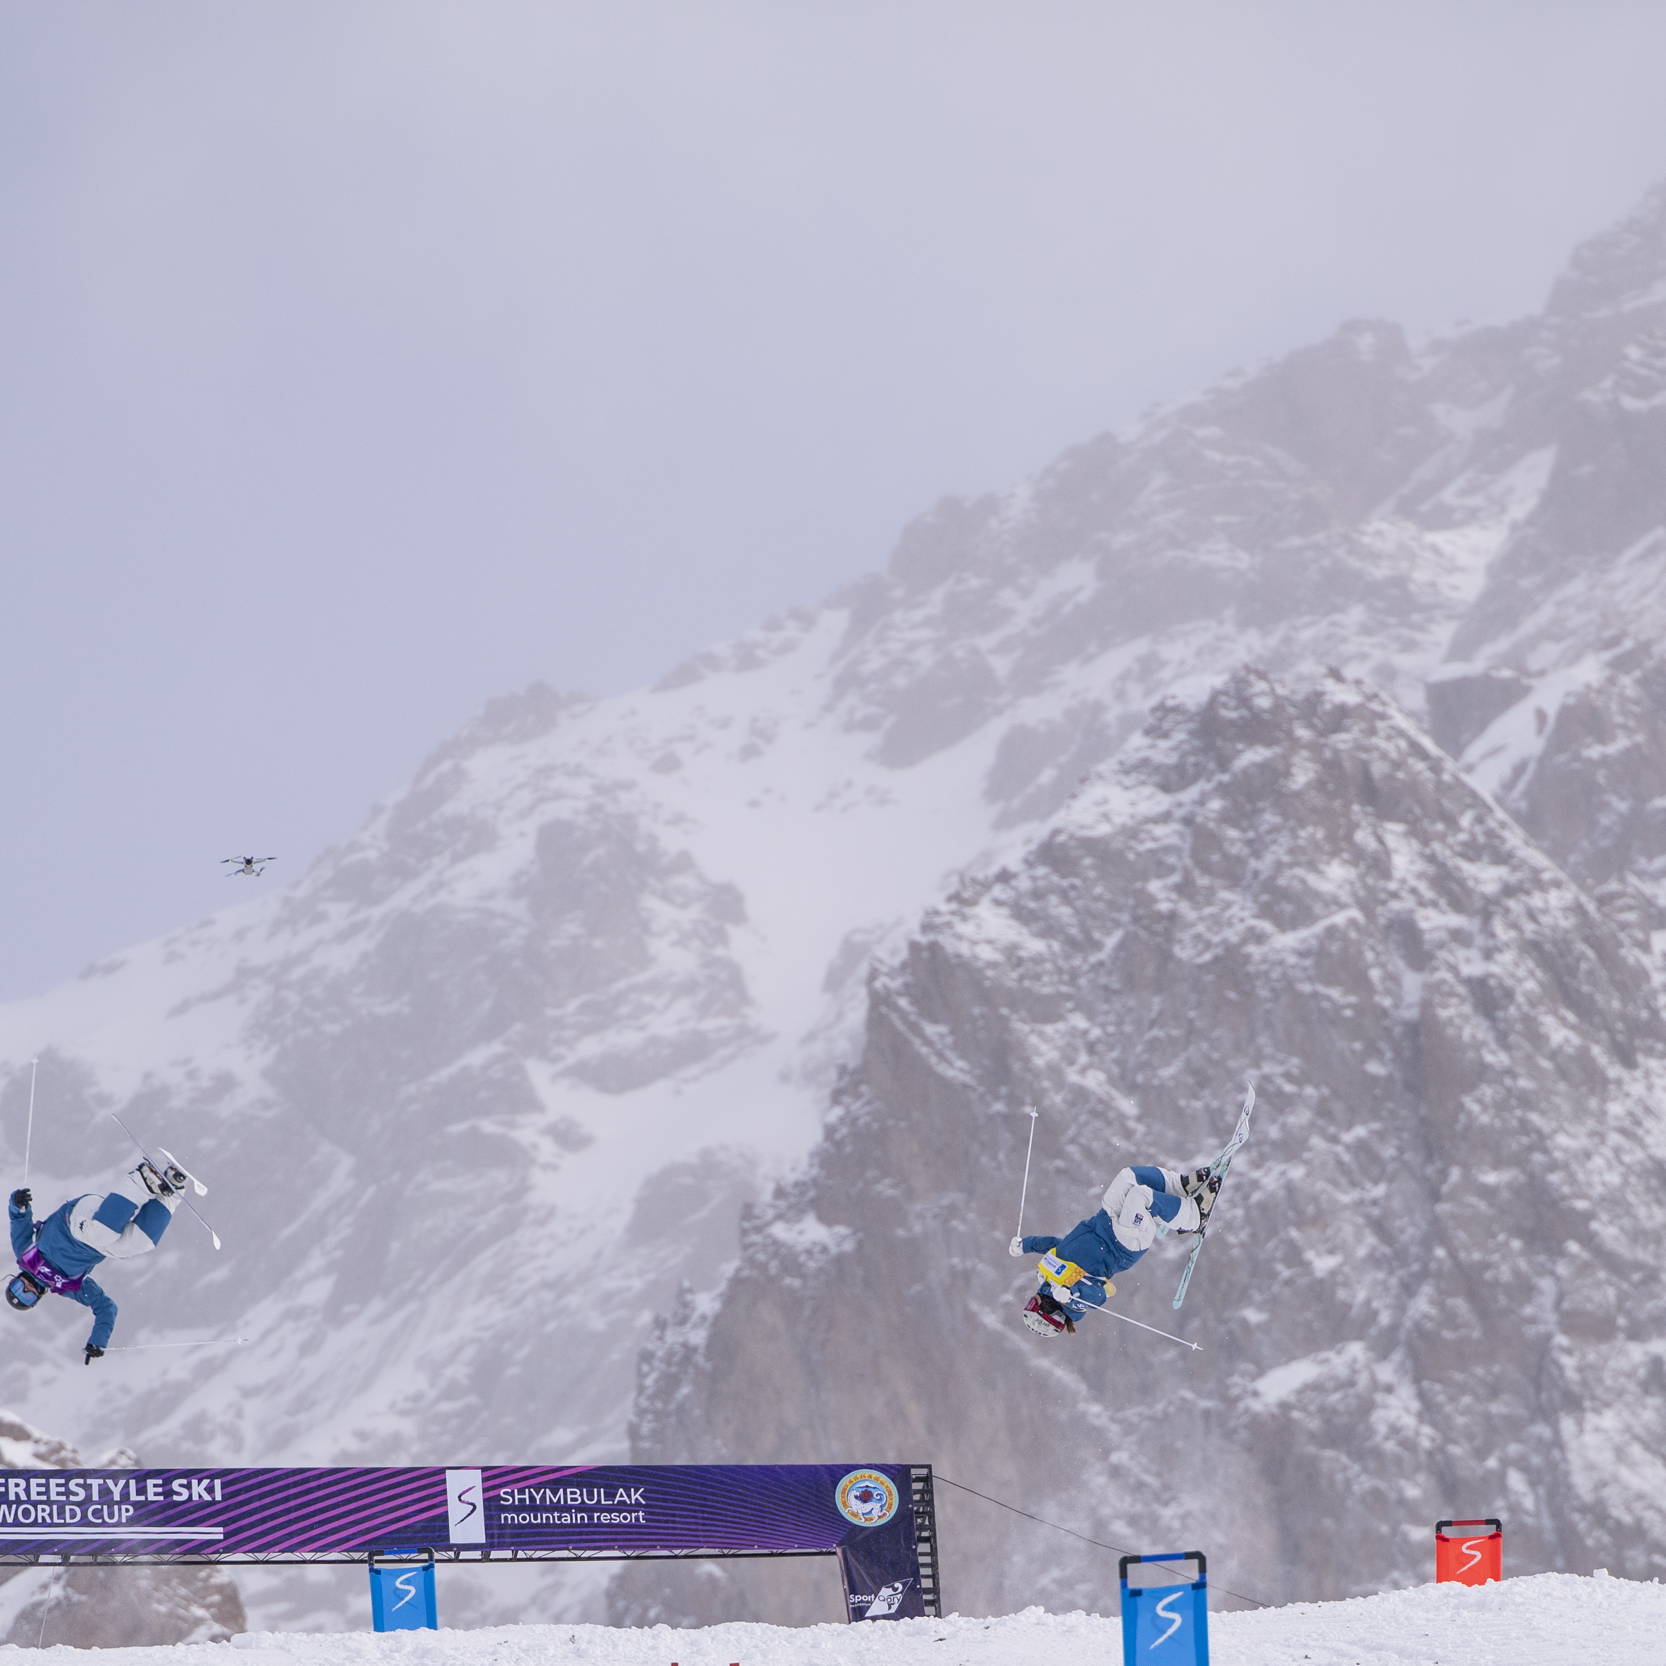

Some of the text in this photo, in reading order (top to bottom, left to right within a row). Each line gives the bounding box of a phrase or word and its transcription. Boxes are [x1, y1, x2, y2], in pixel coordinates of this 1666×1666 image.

[172, 1478, 222, 1501] SKI
[499, 1487, 646, 1505] SHYMBULAK
[87, 1504, 134, 1524] CUP
[500, 1509, 646, 1524] mountain resort
[849, 1593, 875, 1604] Sport
